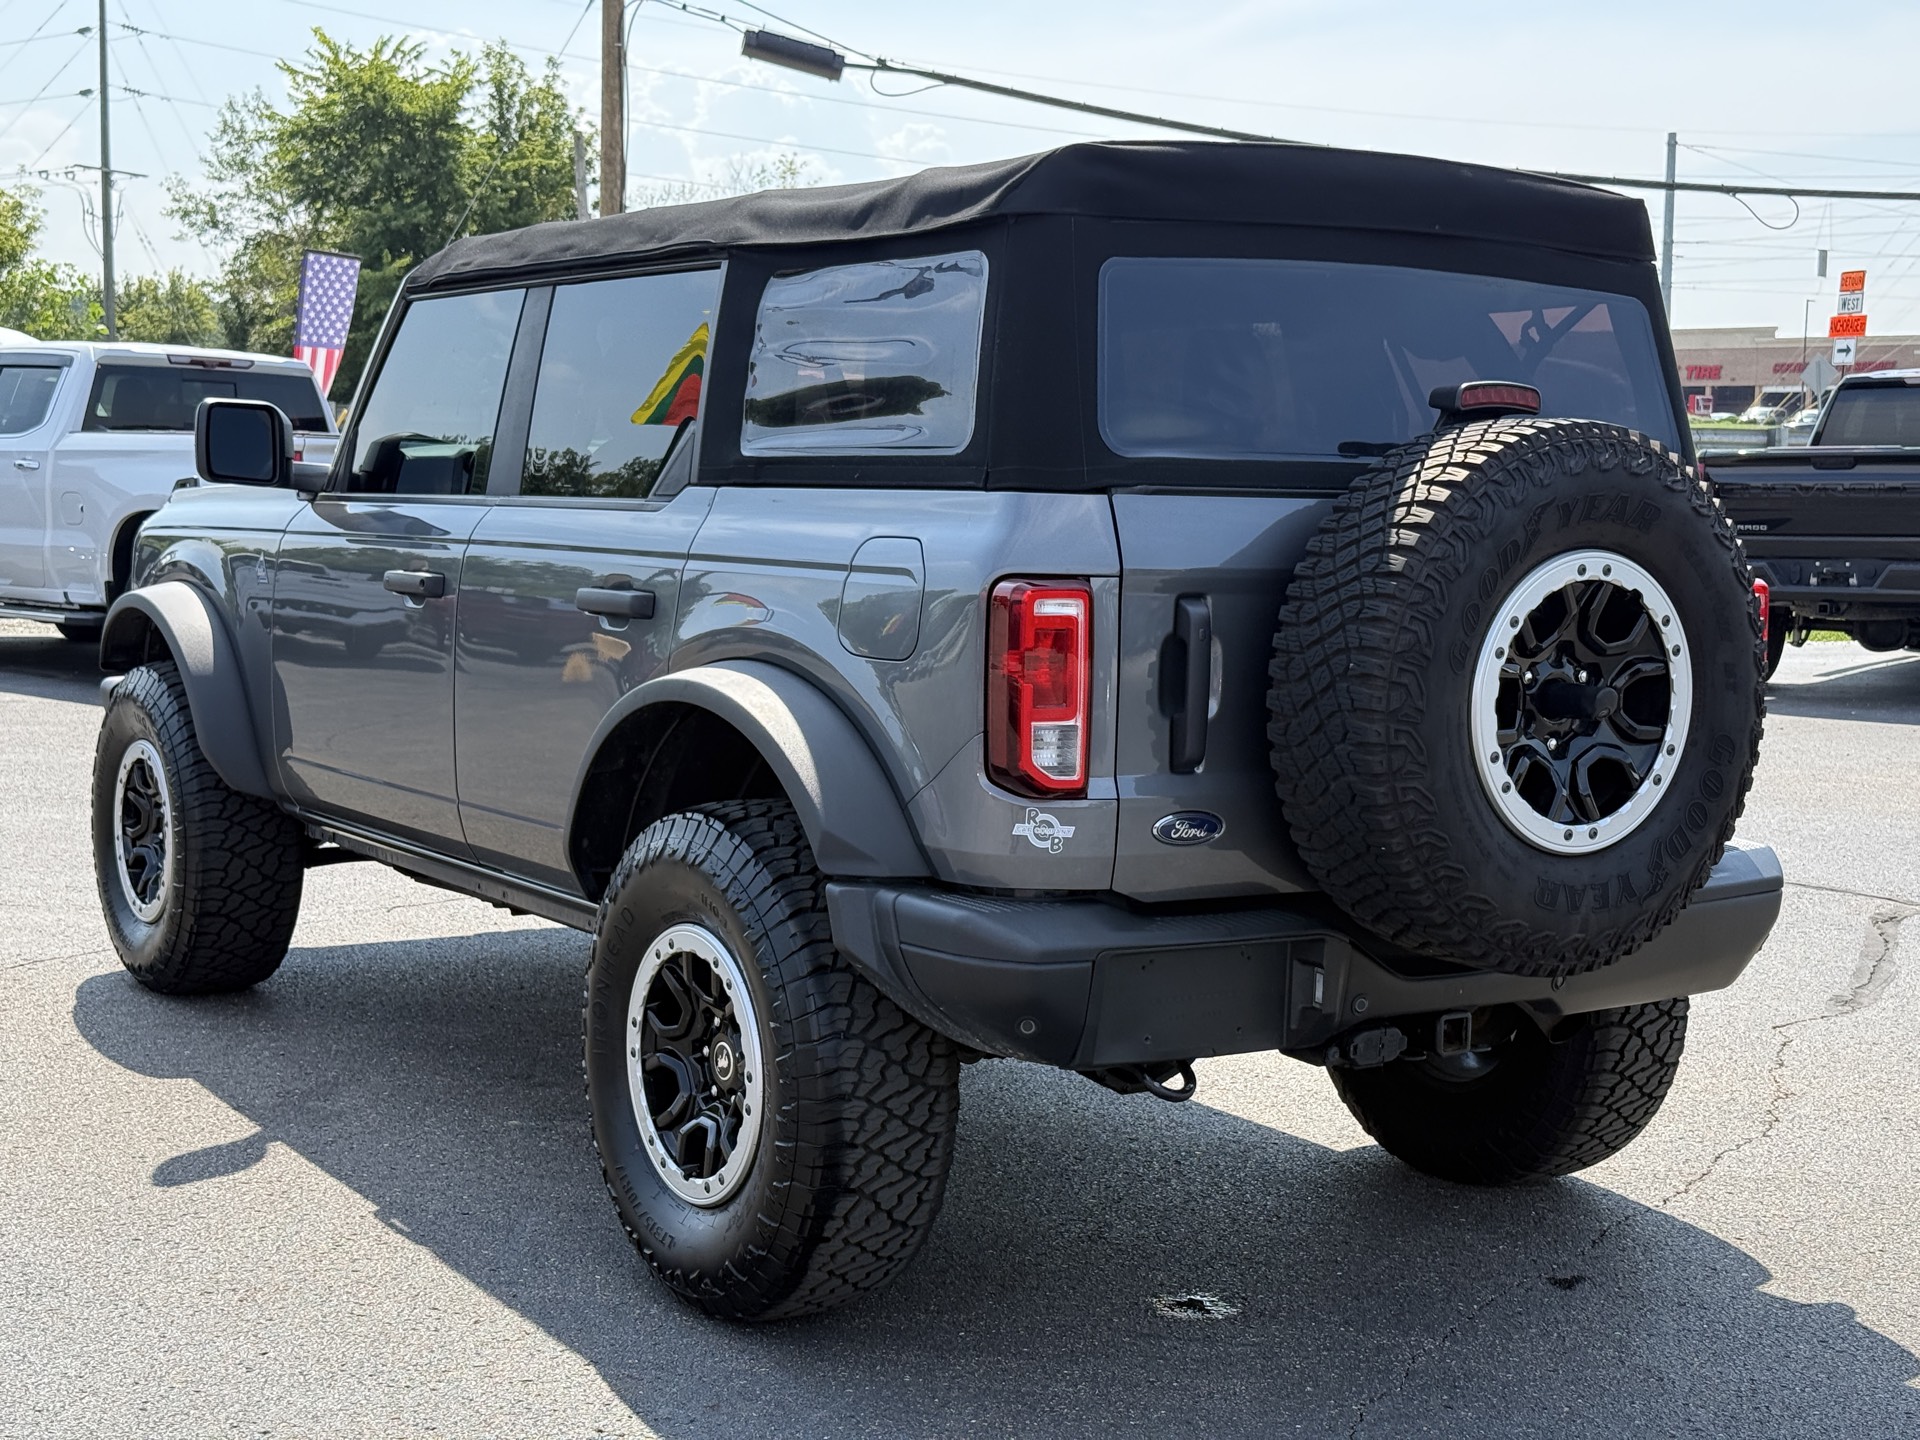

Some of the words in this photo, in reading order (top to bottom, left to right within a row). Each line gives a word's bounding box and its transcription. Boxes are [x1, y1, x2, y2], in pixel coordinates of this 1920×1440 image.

[1841, 276, 1863, 287] DETOUR
[1841, 297, 1860, 311] WEST
[1686, 364, 1723, 381] TIRE
[1171, 819, 1208, 838] Ford
